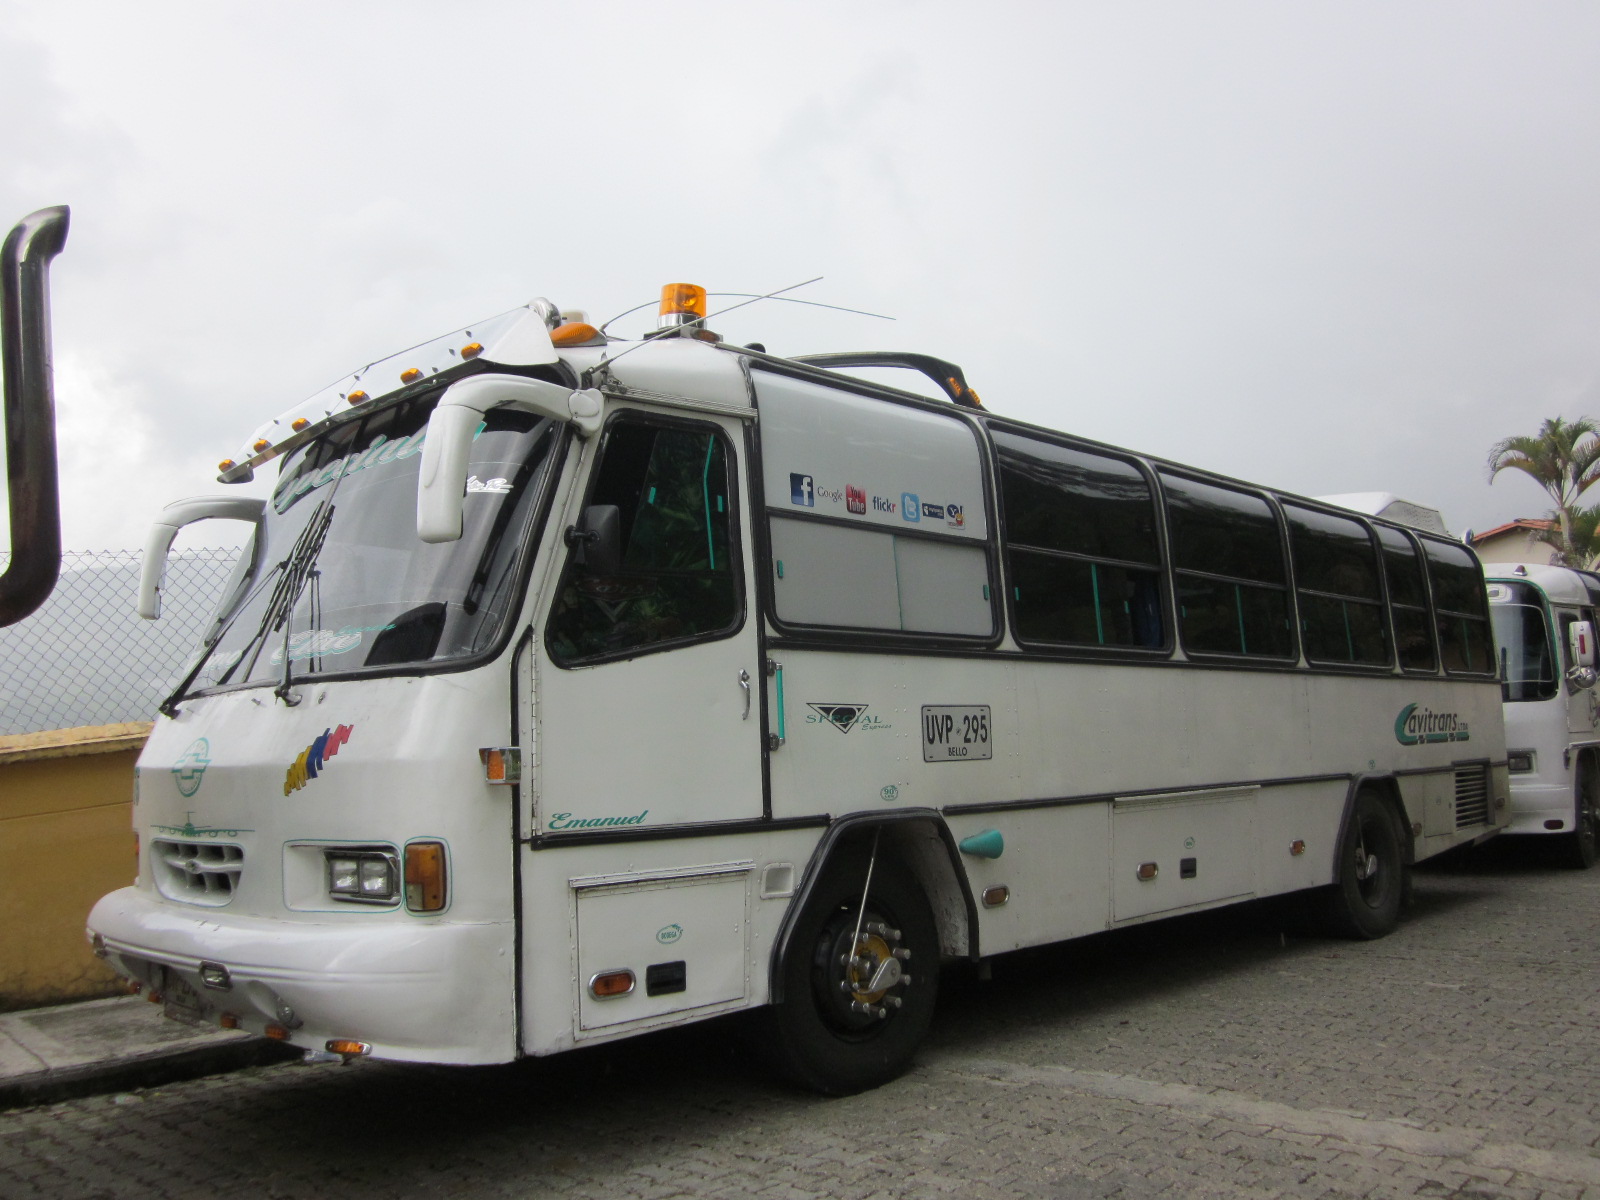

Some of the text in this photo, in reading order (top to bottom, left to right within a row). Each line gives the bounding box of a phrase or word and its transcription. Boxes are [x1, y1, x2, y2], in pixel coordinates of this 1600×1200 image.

[817, 486, 843, 502] Google
[850, 486, 862, 499] You
[847, 497, 865, 513] Tube
[872, 495, 897, 513] flickr
[805, 714, 883, 724] SPECIAL
[1394, 702, 1458, 746] Cavitrans
[925, 714, 989, 745] UVP 295
[947, 746, 968, 757] BELLO
[548, 809, 649, 830] Emanuel
